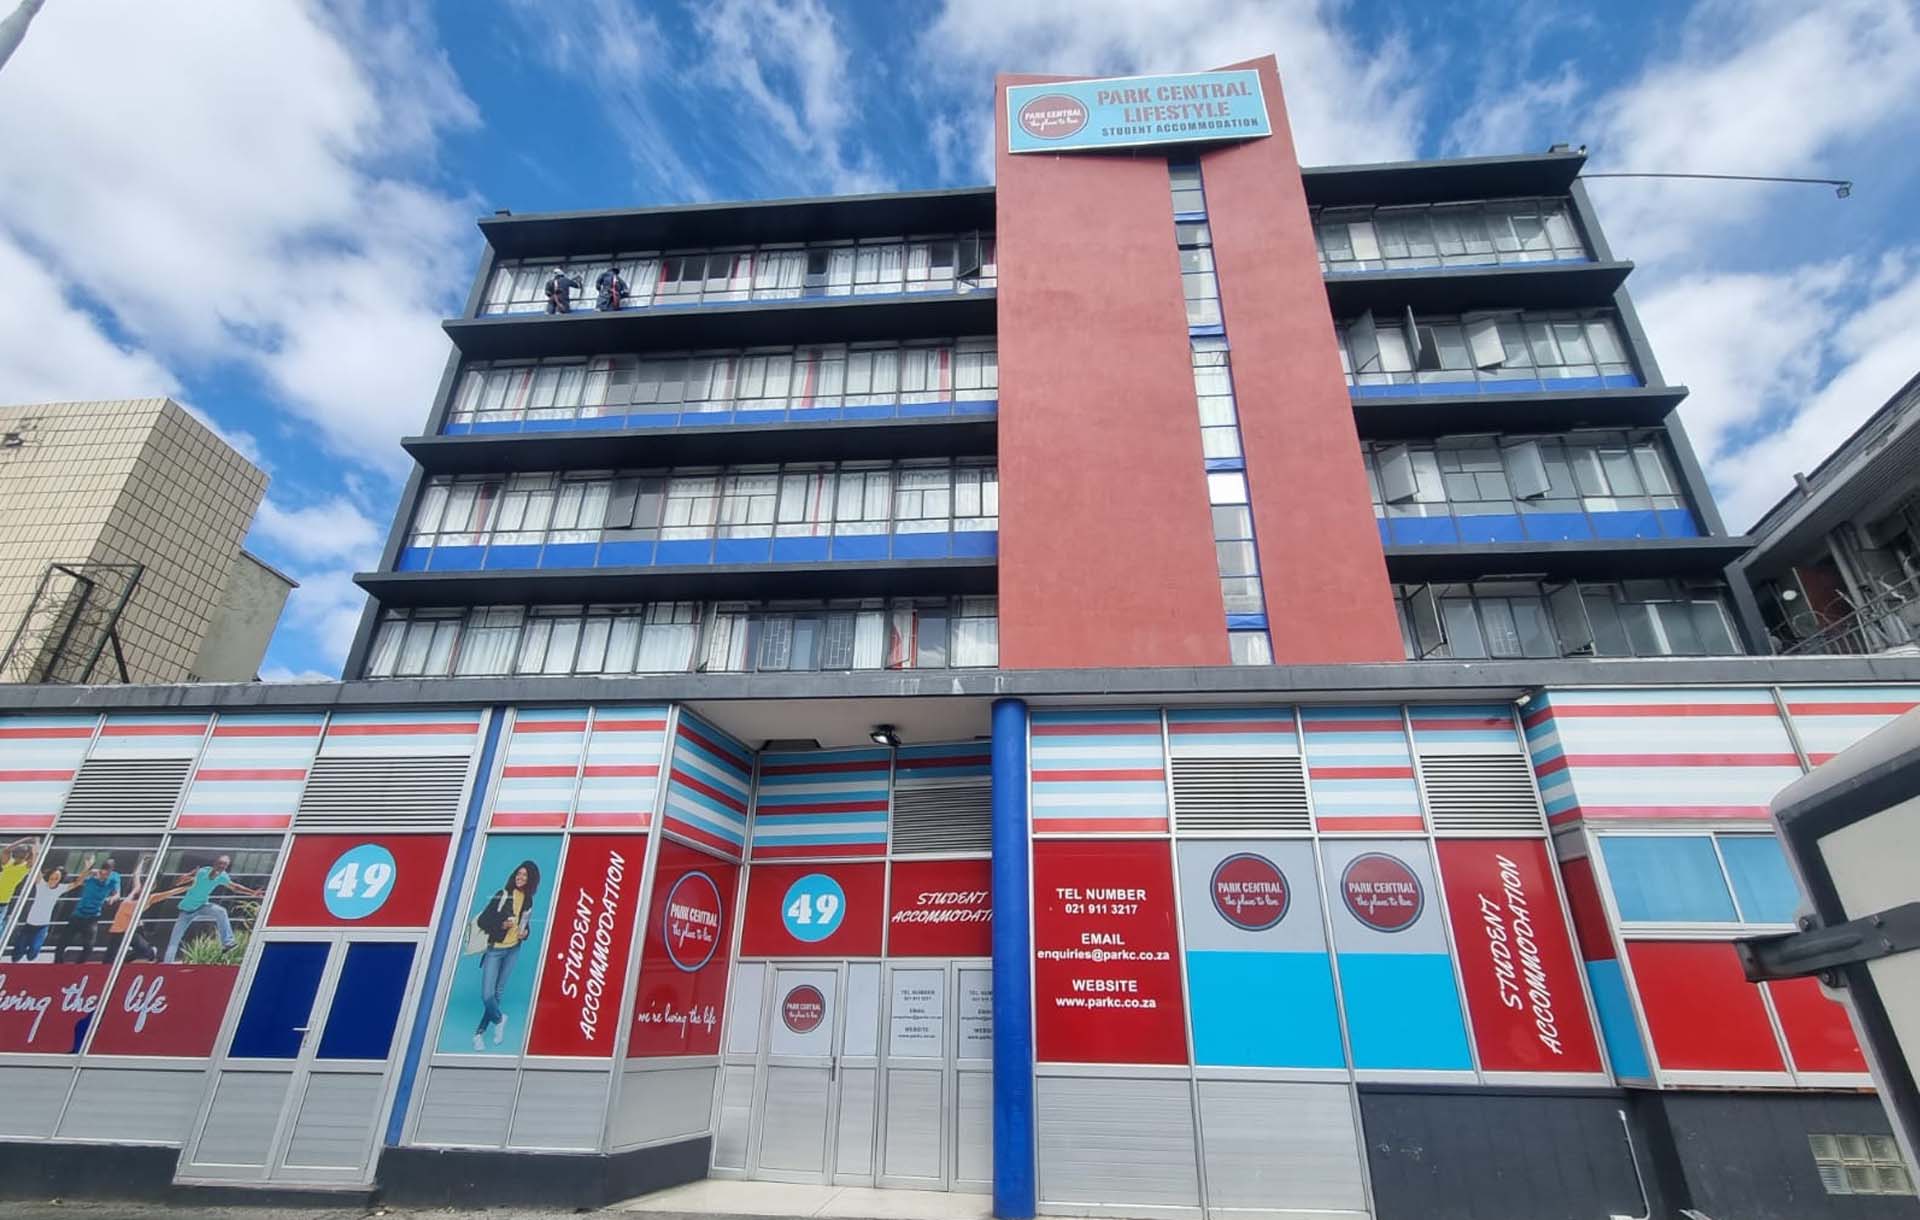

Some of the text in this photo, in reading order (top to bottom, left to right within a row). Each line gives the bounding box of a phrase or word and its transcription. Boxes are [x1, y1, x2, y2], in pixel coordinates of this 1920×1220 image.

[1096, 81, 1253, 106] PARK CENTRAL
[1123, 101, 1231, 123] LIFESTYLE
[1102, 118, 1259, 137] STUDENT ACCOMMODATION
[327, 862, 392, 898] 49
[1217, 882, 1283, 894] PARK CENTRAL
[1348, 882, 1416, 894] PARK CENTRAL
[917, 891, 989, 905] STUDENT
[1056, 888, 1147, 901] TEL NUMBER
[670, 903, 718, 927] PARK CENTRAL
[787, 894, 839, 924] 49
[892, 909, 993, 924] ACCOMMODATI
[1065, 903, 1139, 915] 021 911 3217
[562, 888, 595, 998] STUDENT
[579, 850, 626, 1041] ACCOMMODATION
[1081, 933, 1126, 945] EMAIL
[1037, 948, 1171, 962] enquiries@parkc.co.za
[1478, 893, 1524, 1010] STUDENT
[1495, 854, 1564, 1055] ACCOMMODATION
[1072, 979, 1139, 992] WEBSITE
[61, 975, 99, 1013] the
[124, 975, 169, 1033] life
[1055, 996, 1157, 1010] www.parkc.co.za
